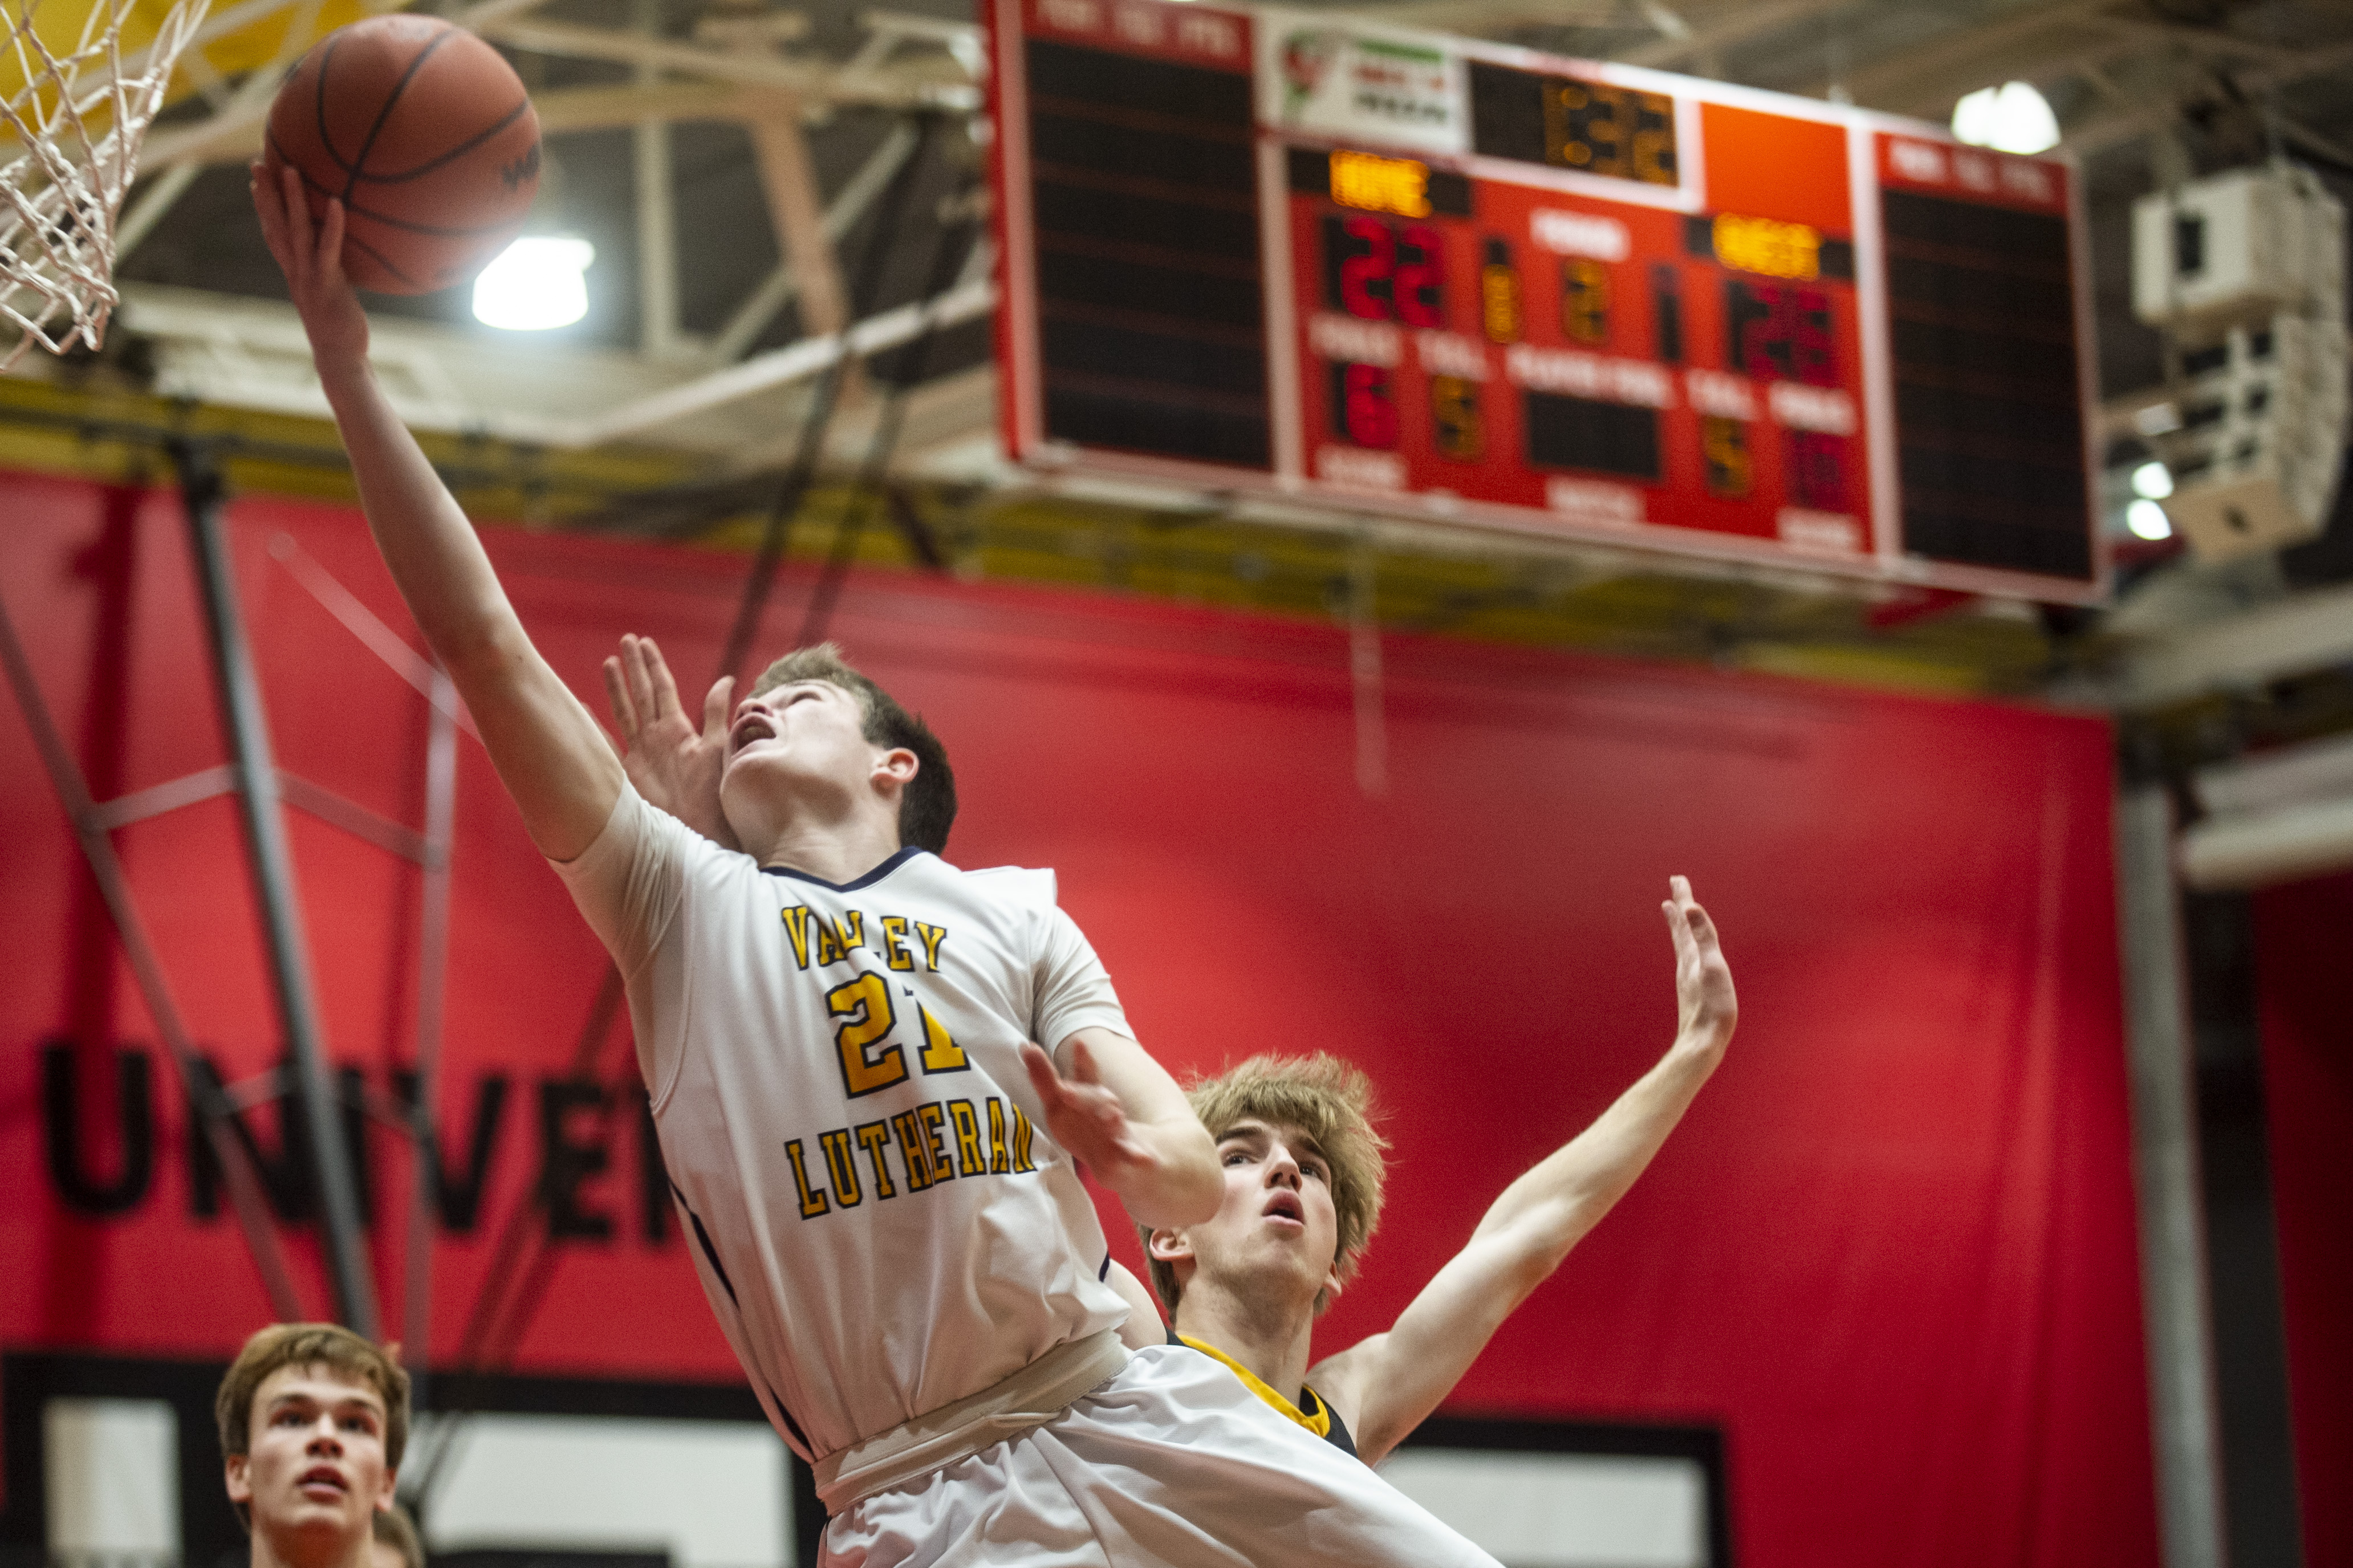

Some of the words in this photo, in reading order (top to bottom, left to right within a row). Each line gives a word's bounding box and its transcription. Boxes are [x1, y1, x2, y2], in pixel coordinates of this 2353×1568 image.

[1342, 219, 1441, 326] 22
[825, 970, 971, 1099] 21
[785, 1097, 1038, 1221] LUTHERAN
